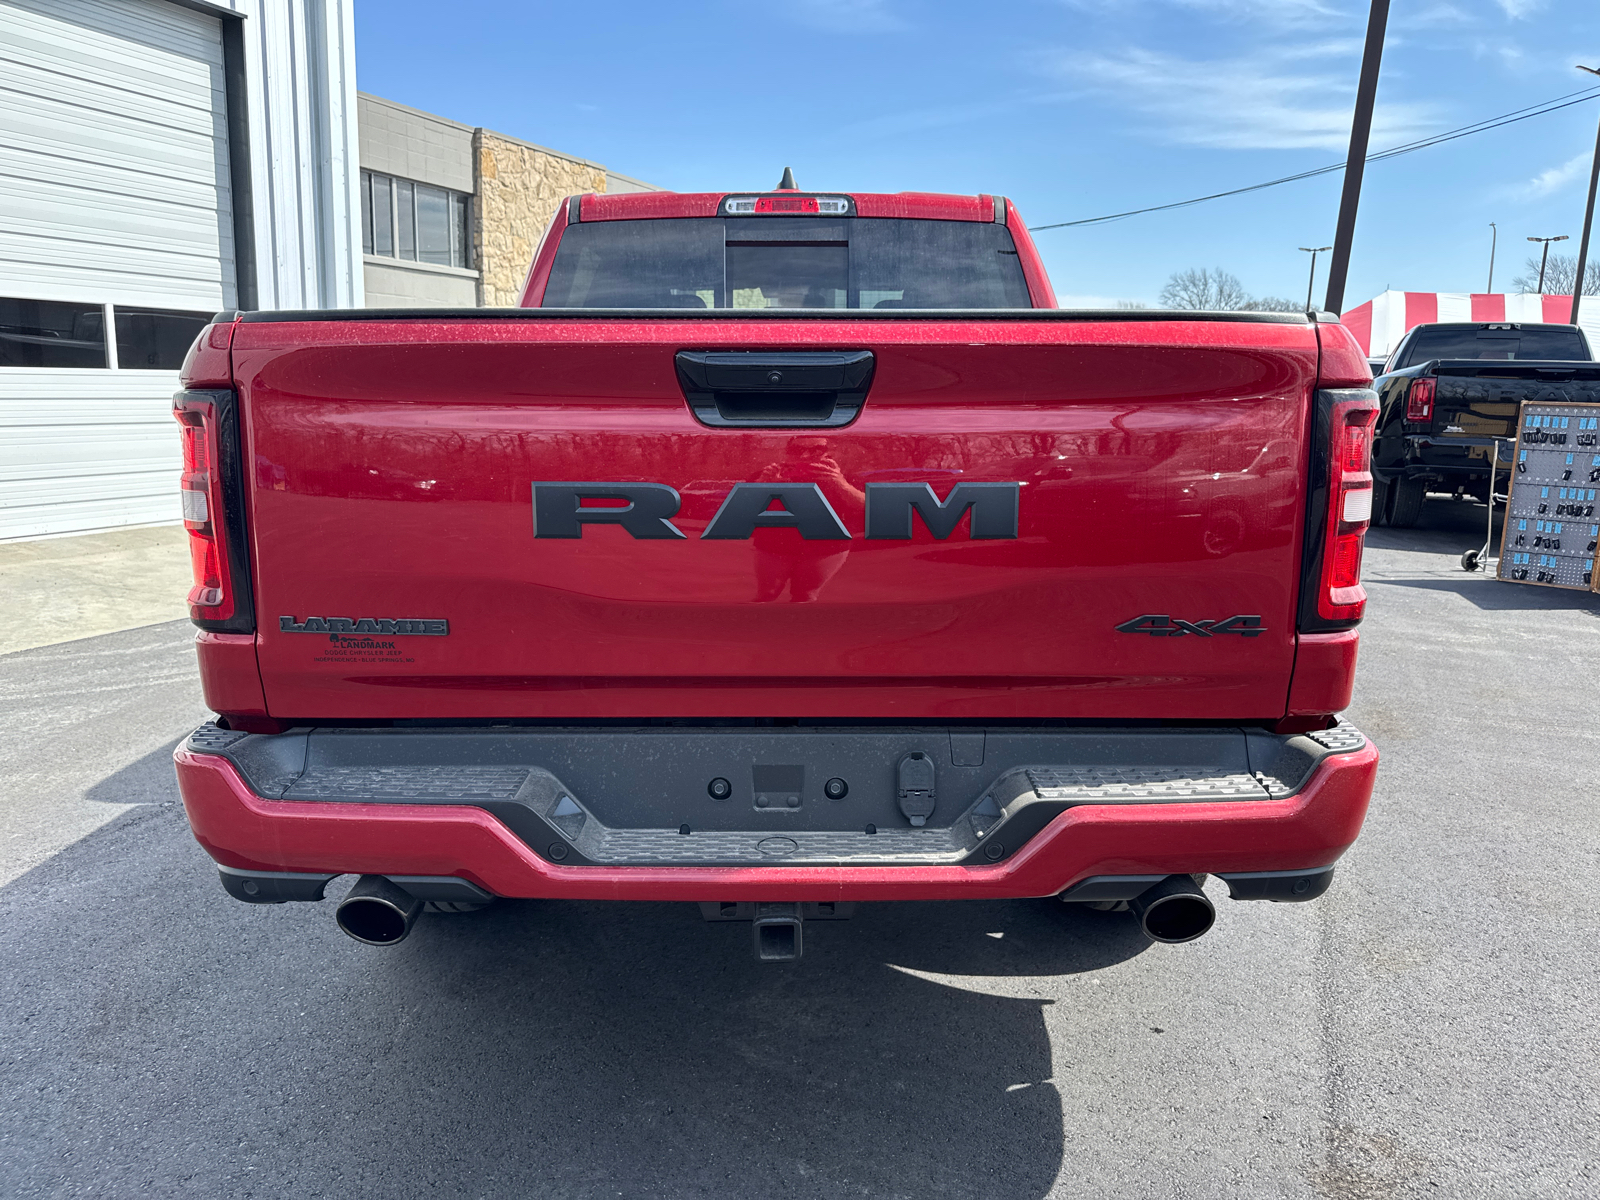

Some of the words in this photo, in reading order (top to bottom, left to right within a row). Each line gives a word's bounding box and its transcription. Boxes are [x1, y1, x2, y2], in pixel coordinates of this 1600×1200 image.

[531, 481, 1019, 540] RAM
[279, 616, 450, 636] LARAMIE
[340, 641, 396, 650] LANDMARK
